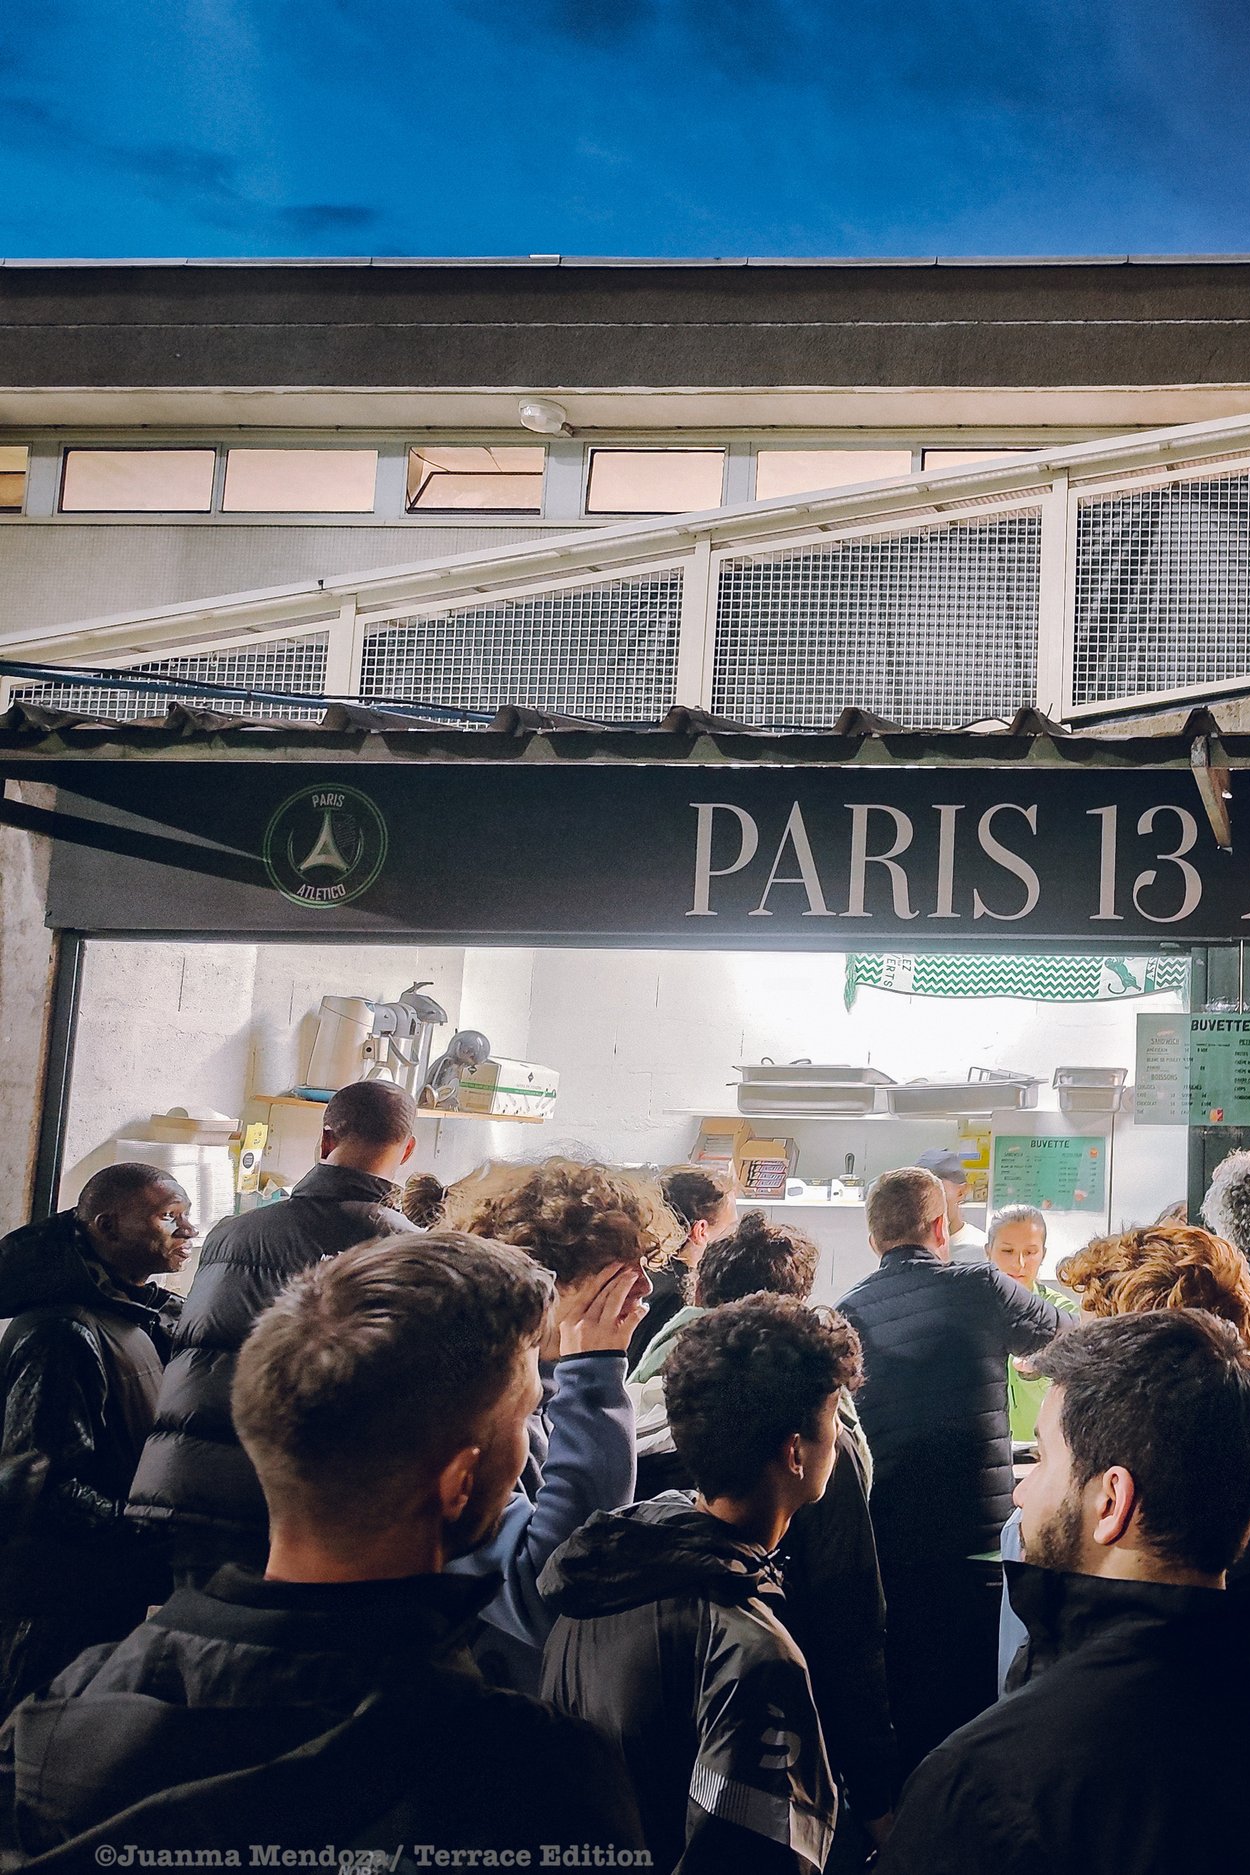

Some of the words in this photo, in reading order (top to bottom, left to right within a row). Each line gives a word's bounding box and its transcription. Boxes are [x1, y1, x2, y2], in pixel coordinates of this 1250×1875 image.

[312, 793, 345, 808] PARIS
[686, 801, 1041, 921] PARIS
[1086, 803, 1202, 923] 13
[297, 883, 346, 901] ATLETICO
[1191, 1019, 1250, 1032] BUVETTE
[1030, 1139, 1070, 1149] BUVETTE
